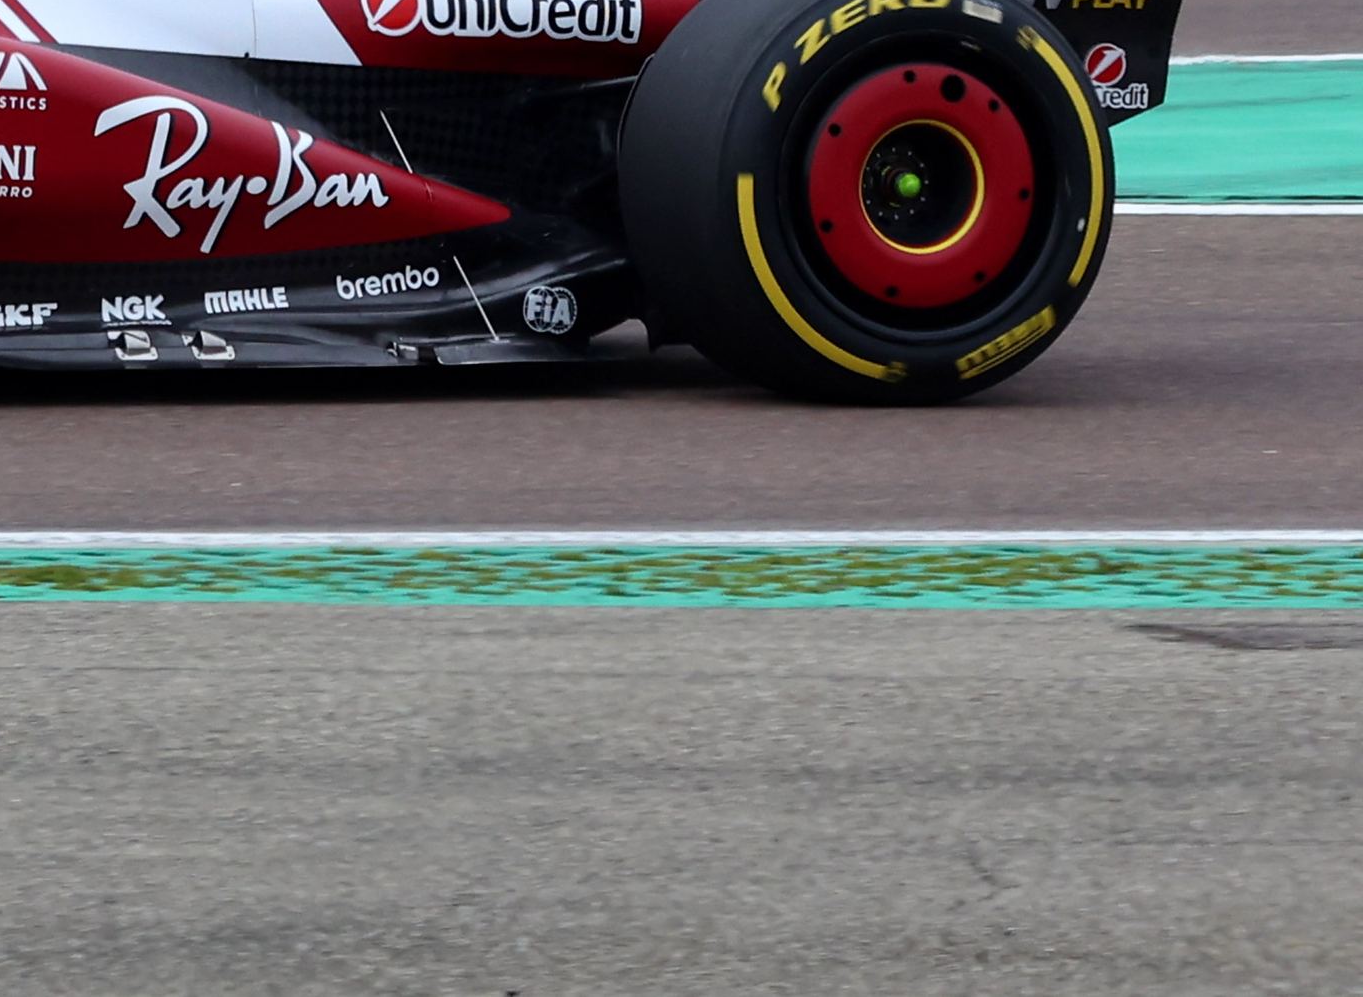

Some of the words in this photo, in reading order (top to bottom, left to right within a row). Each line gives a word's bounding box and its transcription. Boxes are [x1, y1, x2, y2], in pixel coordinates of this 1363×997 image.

[336, 264, 440, 301] brembo
[101, 293, 166, 322] NGK
[204, 286, 289, 314] MAHLE
